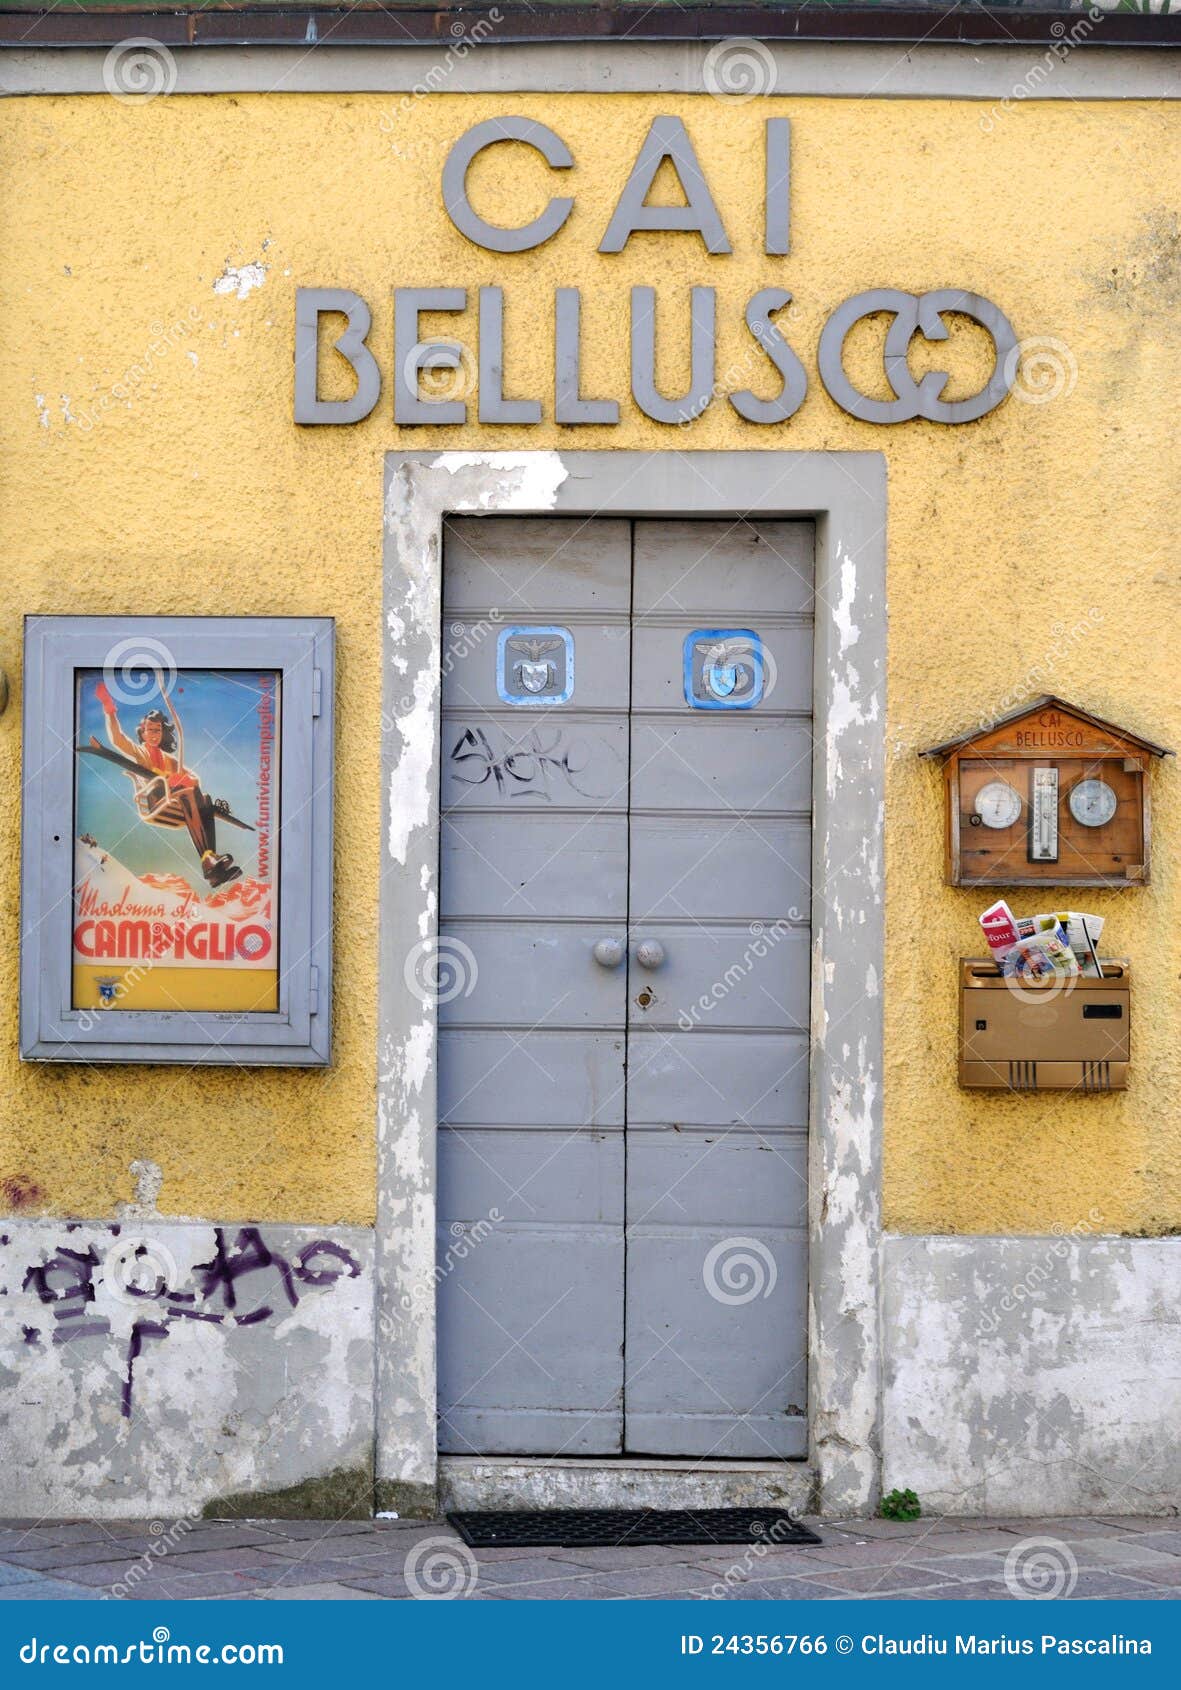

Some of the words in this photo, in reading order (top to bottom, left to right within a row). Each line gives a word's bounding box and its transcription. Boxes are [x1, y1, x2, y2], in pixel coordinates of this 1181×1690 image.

[442, 114, 790, 256] CAI
[294, 285, 1019, 426] BELLUSCO
[1016, 731, 1083, 747] BELLUSCO
[1039, 712, 1063, 728] CAI
[255, 676, 275, 878] www.funiviecampiglio.it
[77, 878, 166, 918] Madonna
[74, 919, 272, 961] CAMPIGLIO
